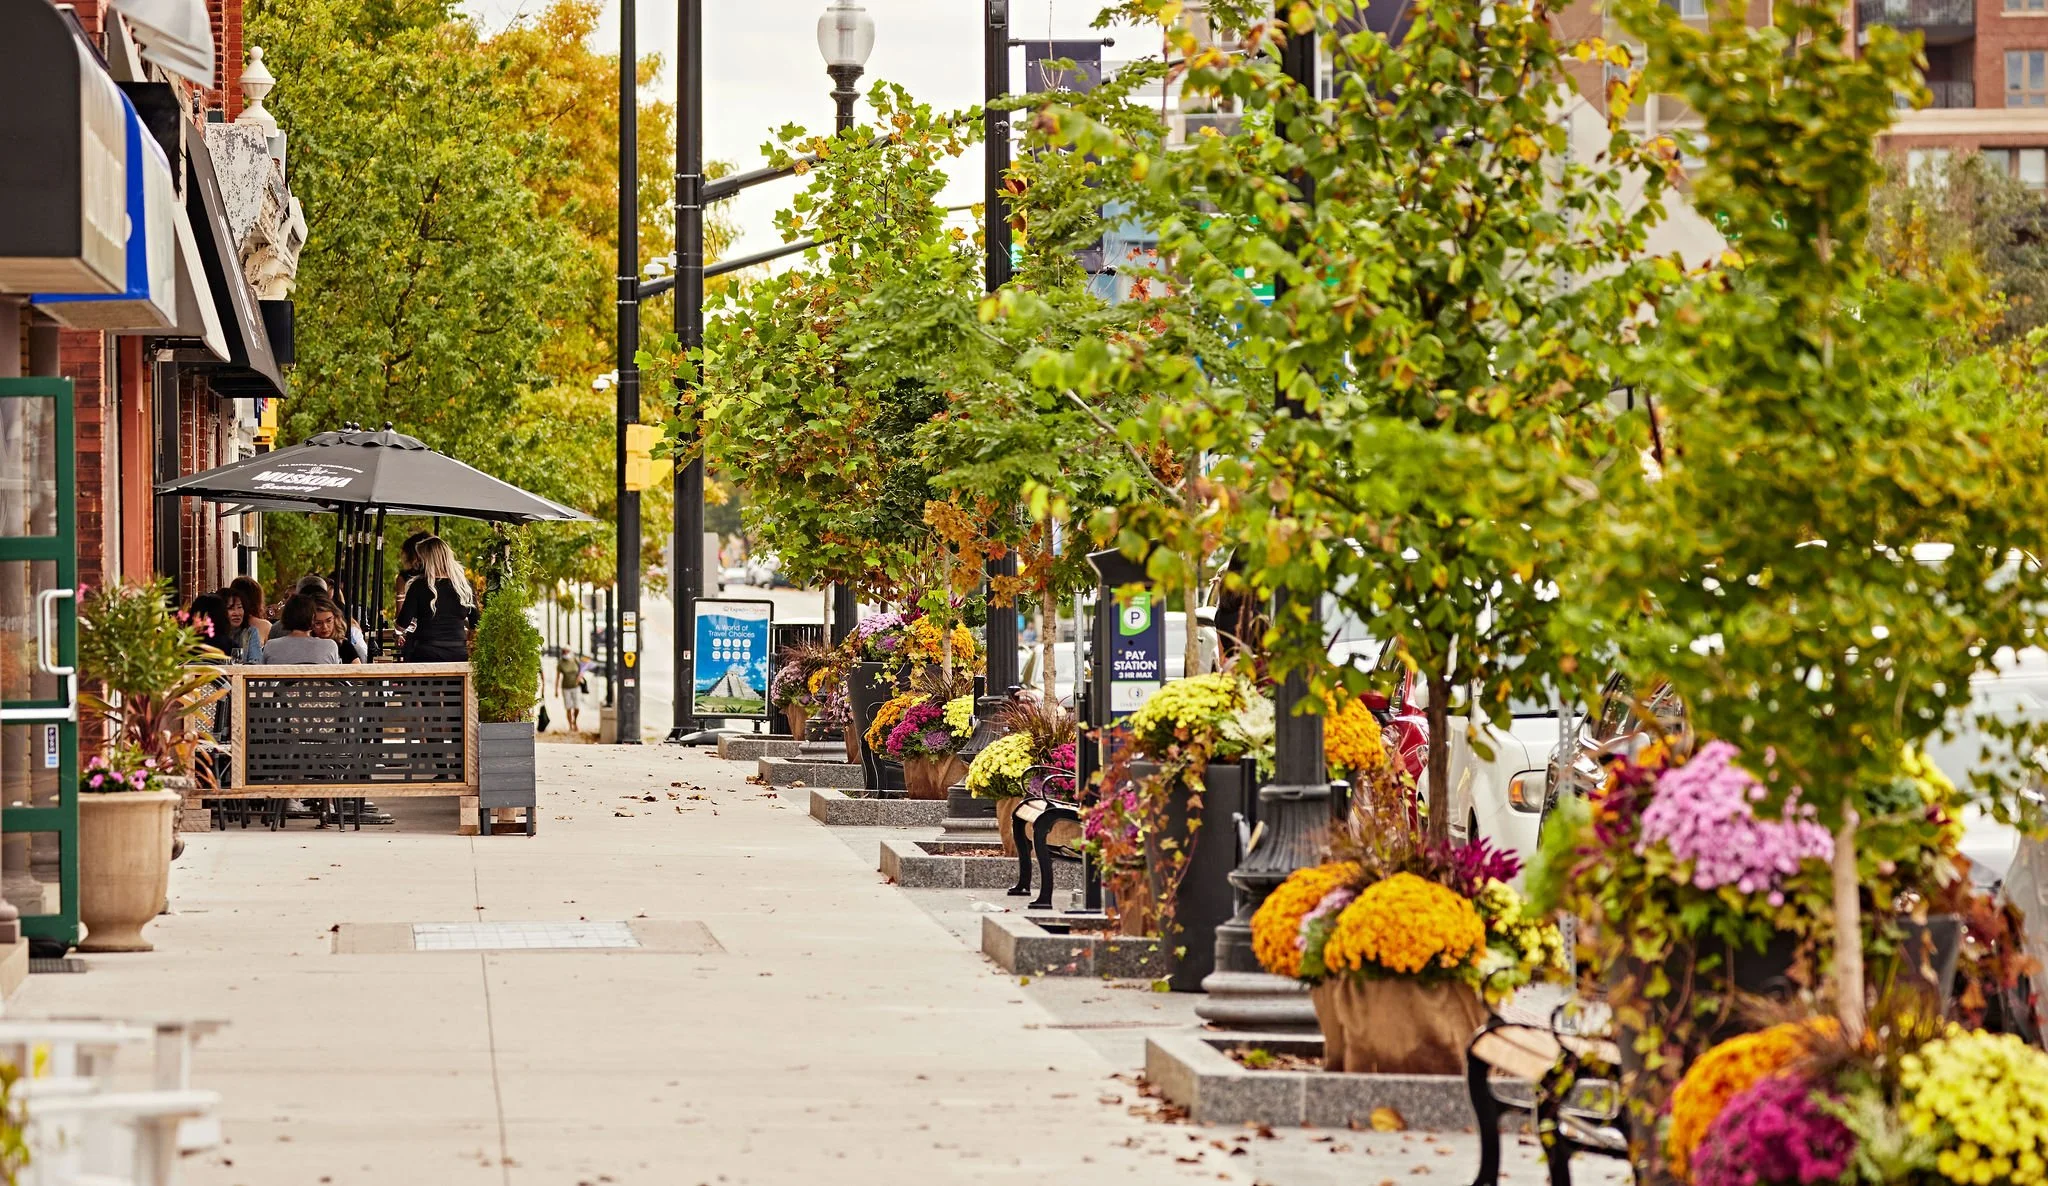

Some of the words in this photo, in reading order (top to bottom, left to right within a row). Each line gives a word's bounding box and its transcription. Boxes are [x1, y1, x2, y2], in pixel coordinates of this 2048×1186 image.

[251, 470, 353, 488] MUSKOKA
[1130, 611, 1141, 624] P
[708, 630, 727, 638] Travel
[1125, 650, 1146, 660] PAY
[1113, 660, 1157, 671] STATION
[1124, 671, 1135, 679] HR
[1135, 671, 1153, 679] MAX
